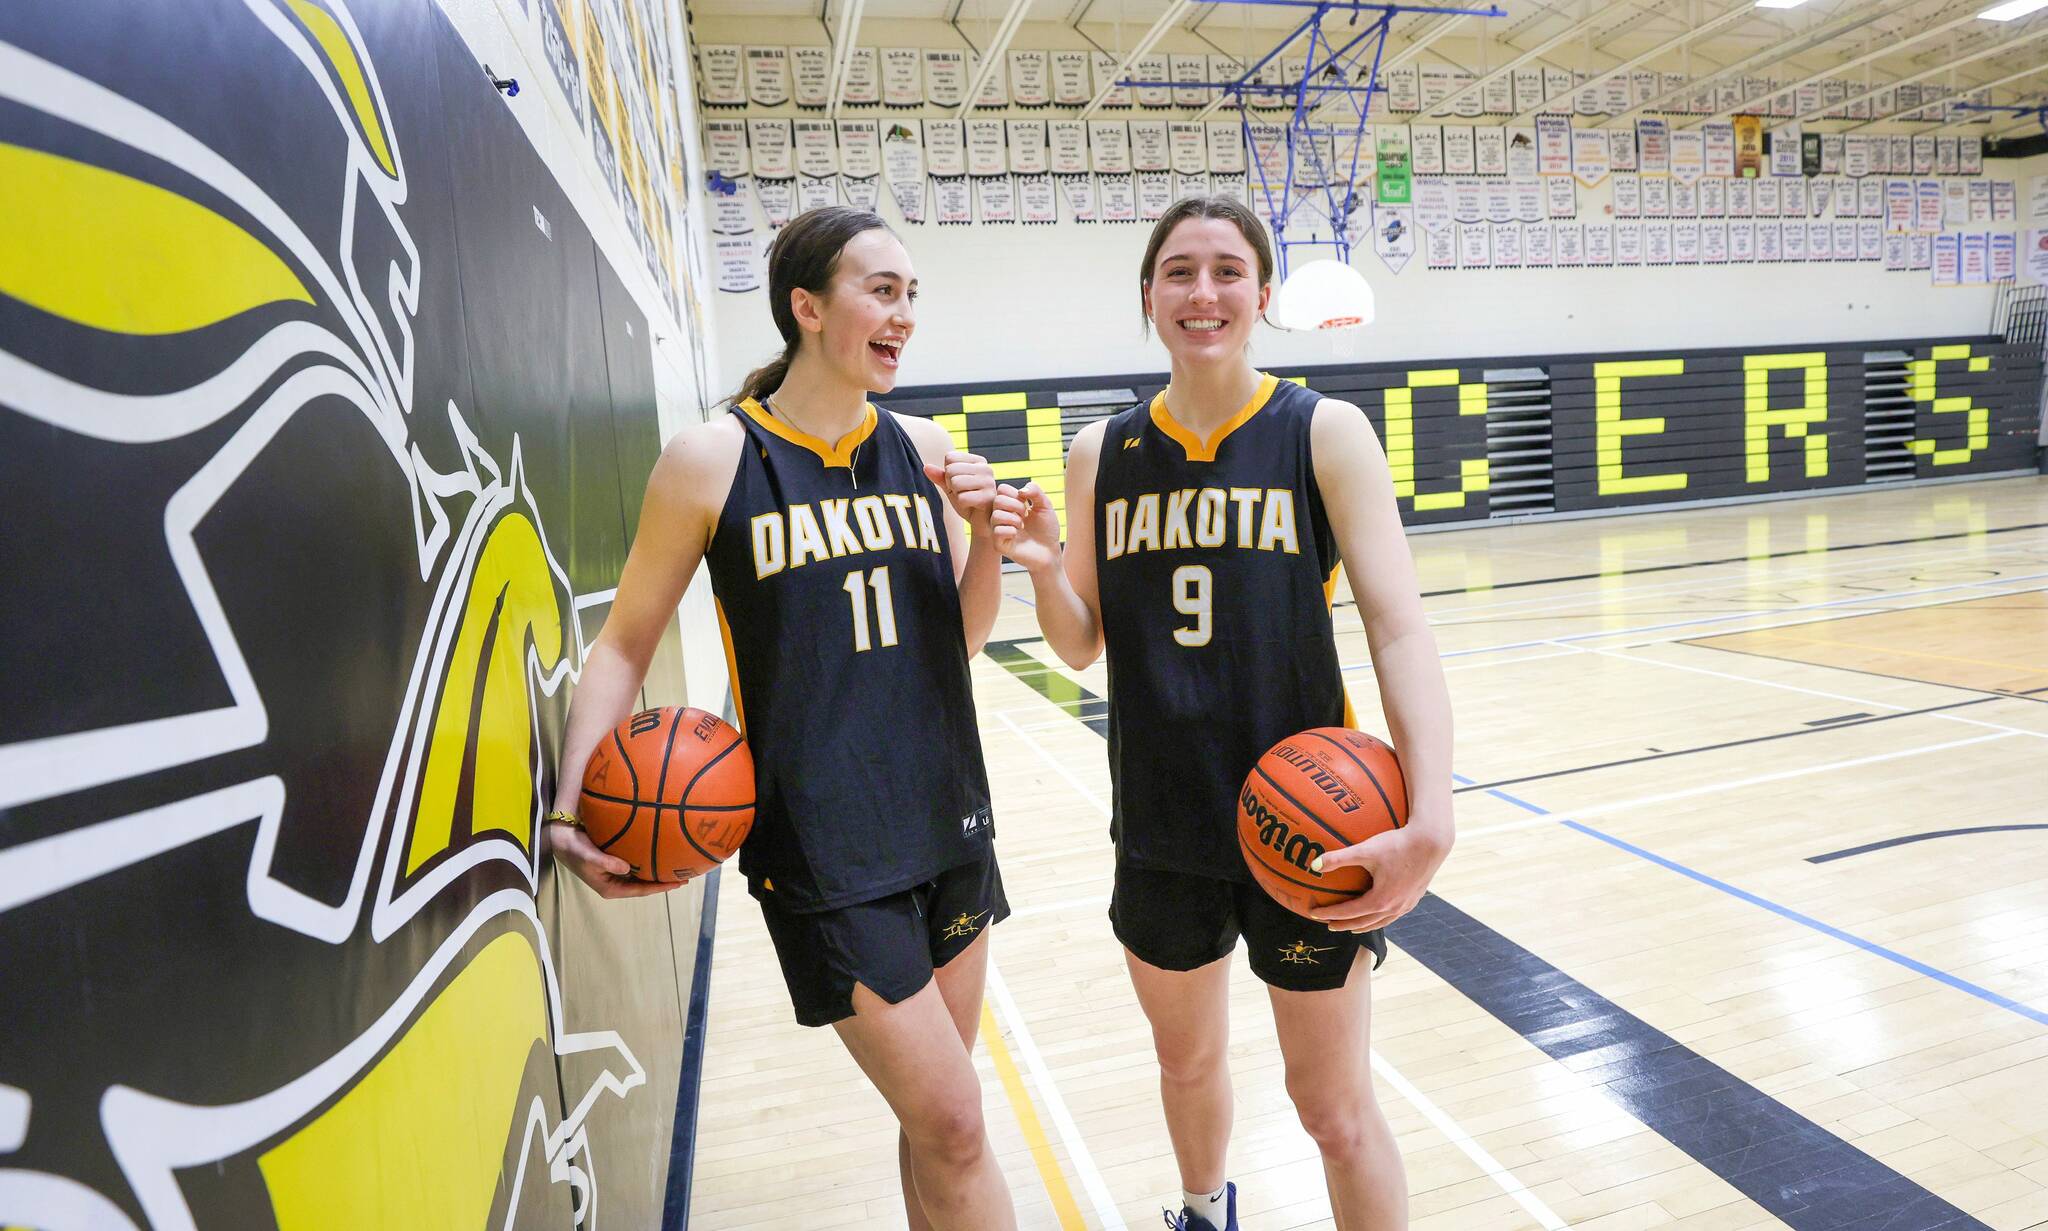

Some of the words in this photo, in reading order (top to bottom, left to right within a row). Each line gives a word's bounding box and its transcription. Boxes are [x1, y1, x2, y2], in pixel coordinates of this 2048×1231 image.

[750, 493, 942, 581] DAKOTA
[1105, 487, 1300, 561] DAKOTA
[843, 565, 899, 653] 11
[1172, 564, 1213, 647] 9
[1271, 745, 1362, 814] EVOLUTION
[1241, 783, 1327, 879] Wilson
